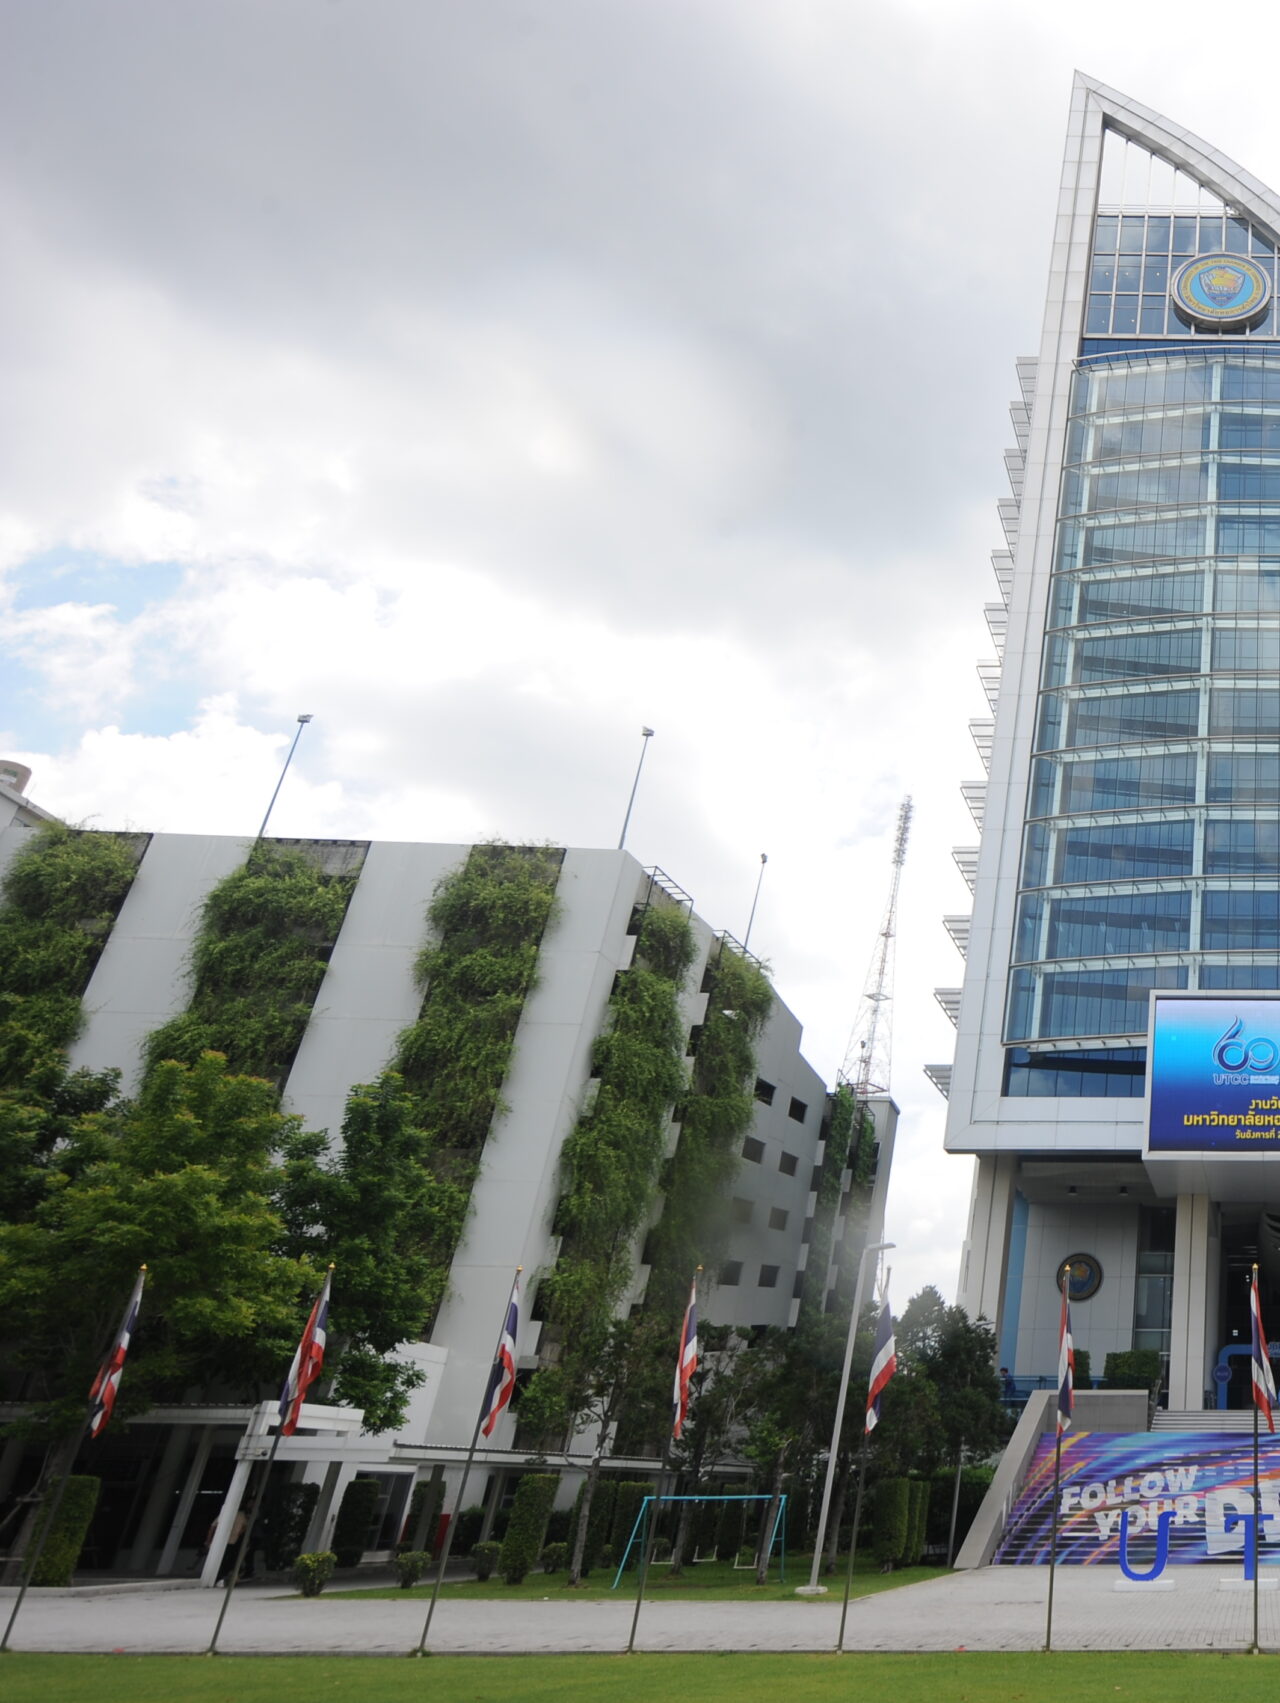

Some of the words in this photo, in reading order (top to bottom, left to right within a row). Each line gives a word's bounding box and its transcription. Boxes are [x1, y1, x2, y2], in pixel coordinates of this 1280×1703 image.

[1213, 1073, 1249, 1086] UTCC
[1235, 1128, 1276, 1139] วันอังคารที่
[1060, 1465, 1198, 1515] FOLLOW
